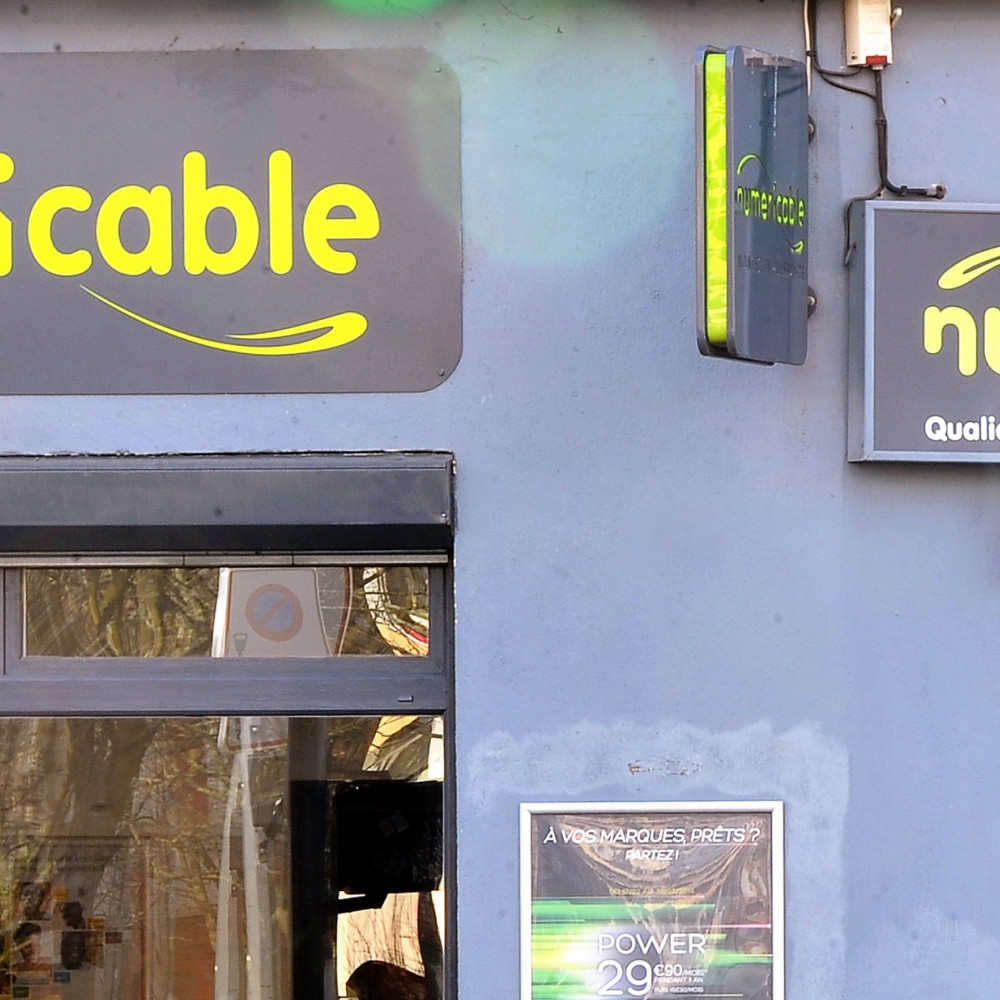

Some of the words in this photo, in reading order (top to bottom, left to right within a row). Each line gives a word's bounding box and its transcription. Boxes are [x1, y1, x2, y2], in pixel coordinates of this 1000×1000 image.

[543, 826, 557, 844] À
[561, 829, 597, 844] VOS
[599, 829, 687, 846] MARQUES,
[691, 825, 746, 843] PRÊTS
[598, 933, 706, 955] POWER
[597, 959, 652, 996] 29
